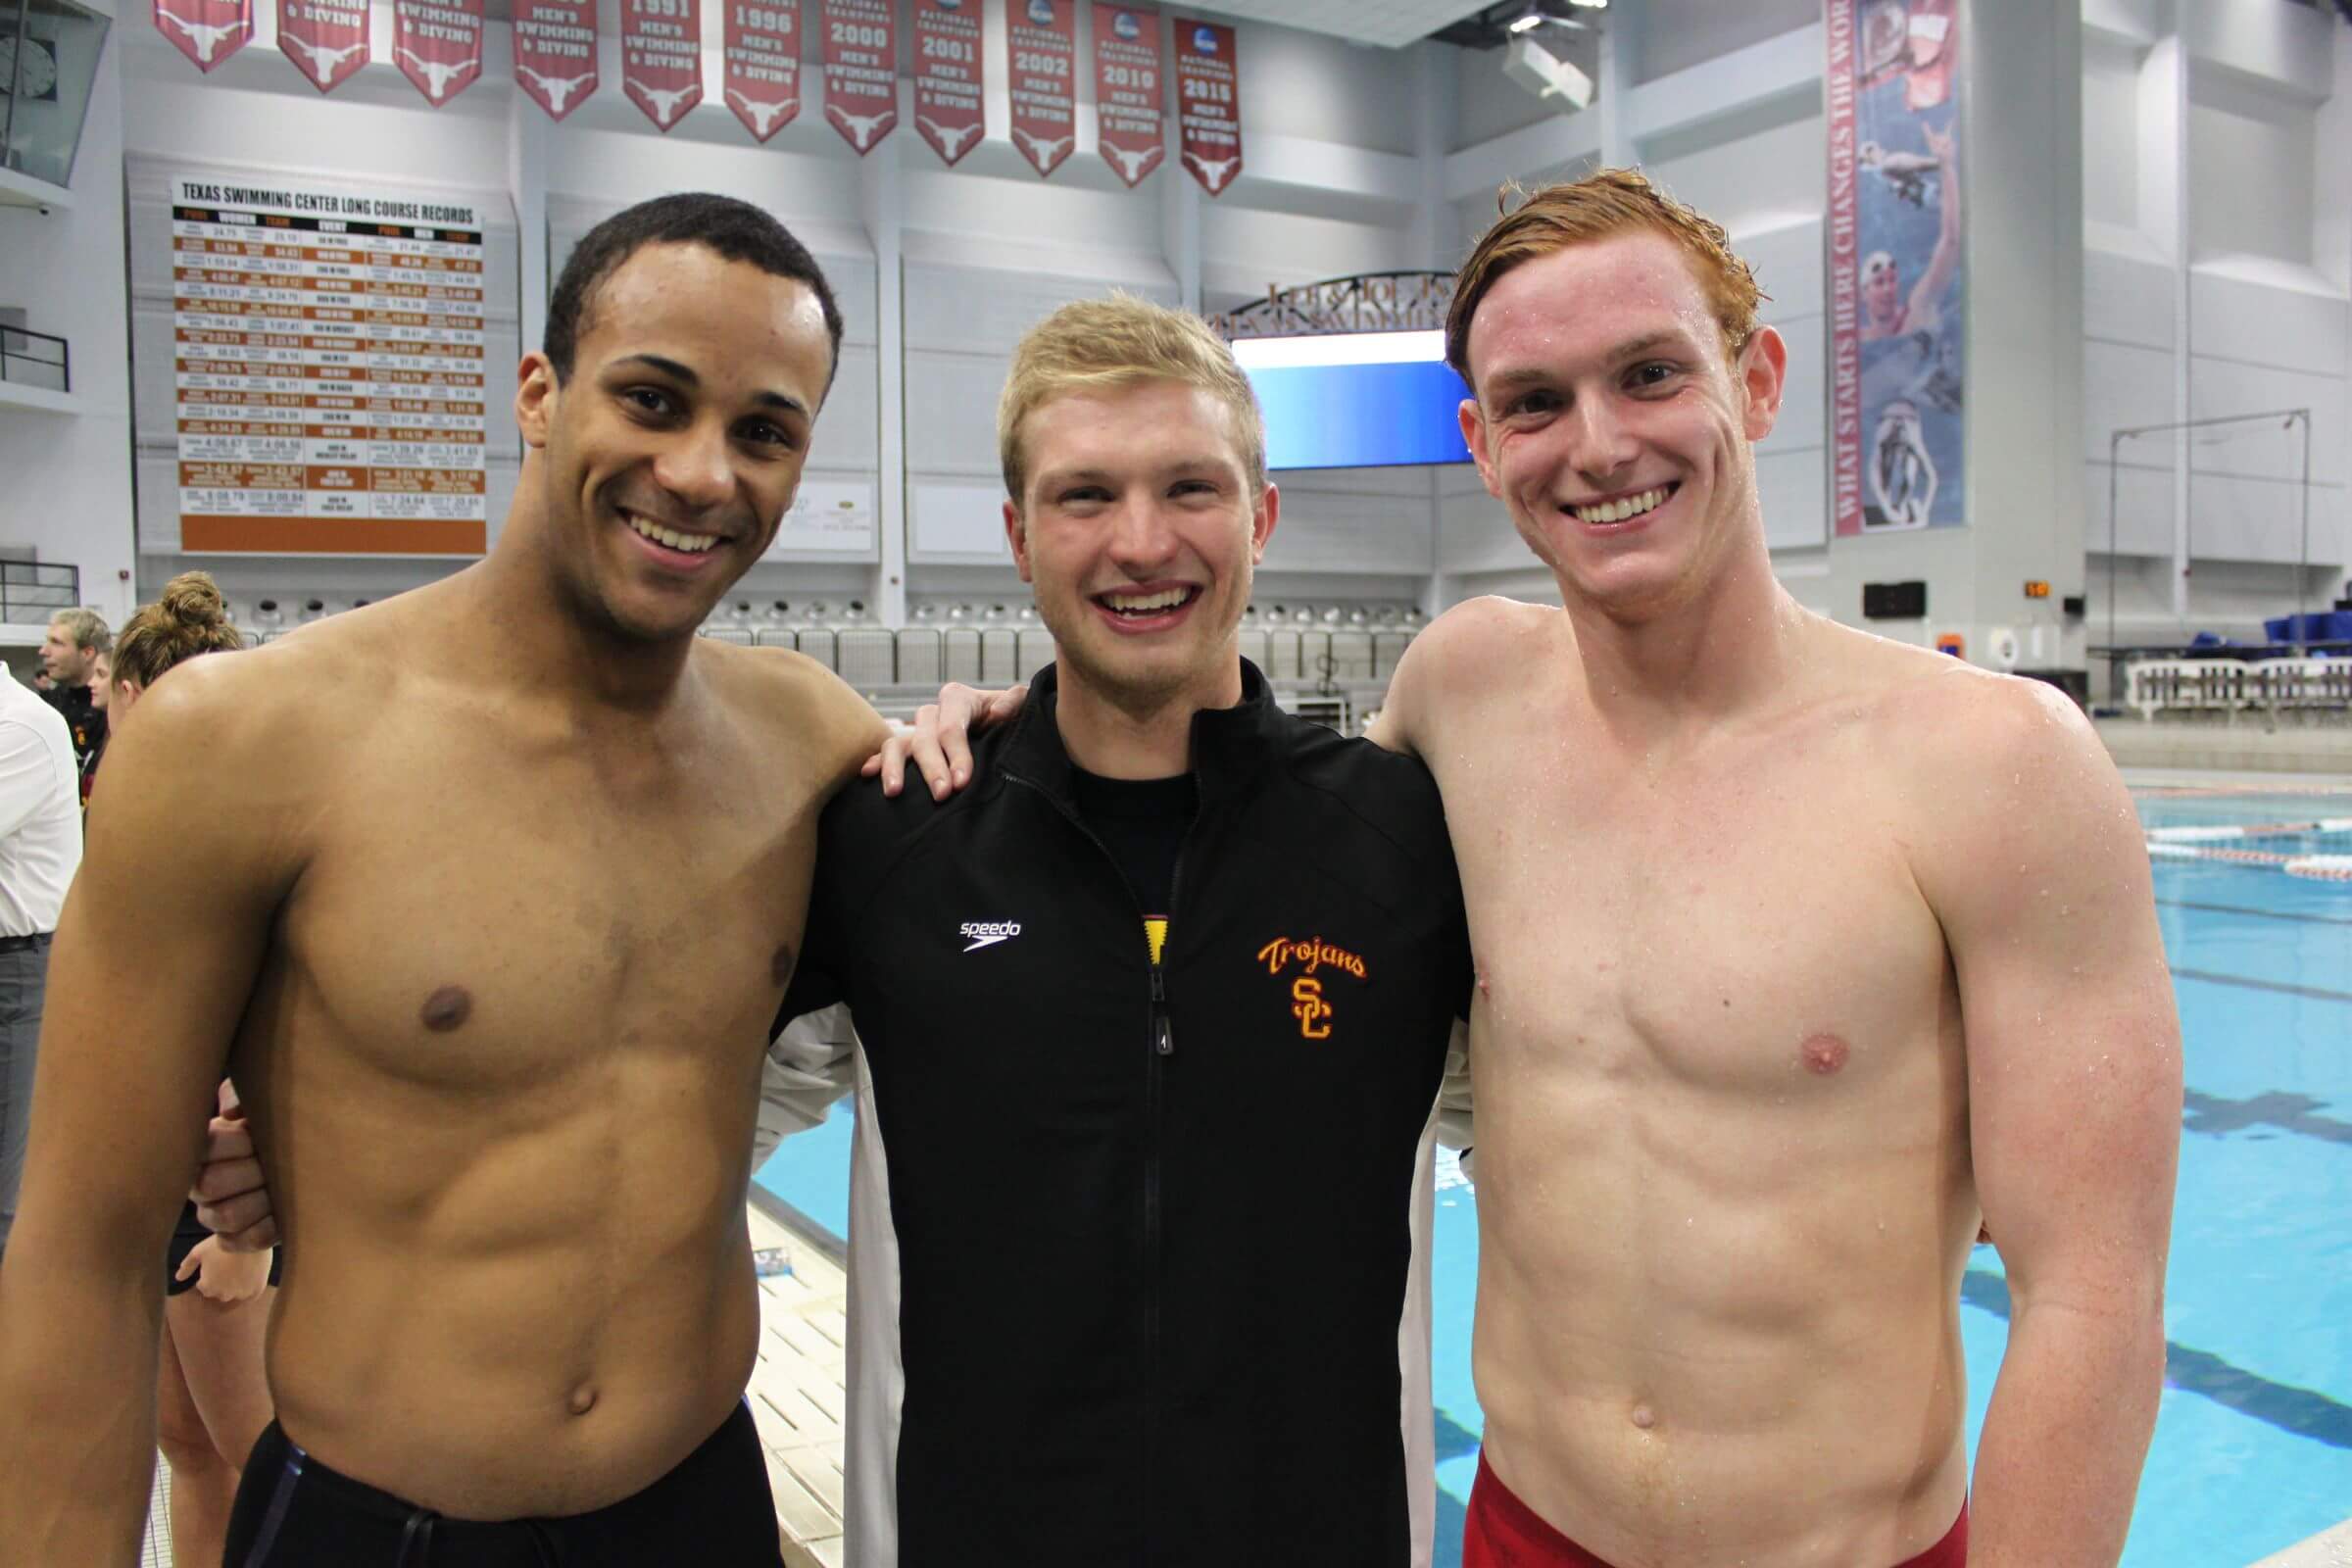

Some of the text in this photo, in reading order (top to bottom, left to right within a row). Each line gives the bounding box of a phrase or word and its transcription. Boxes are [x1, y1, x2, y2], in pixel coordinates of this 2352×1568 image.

[304, 5, 361, 27] DIVING
[398, 1, 479, 28] SWIMMING
[532, 6, 578, 24] MEN'S
[736, 5, 792, 33] 1996
[418, 22, 472, 43] DIVING
[516, 20, 594, 43] SWIMMING
[640, 21, 683, 37] MEN'S
[830, 22, 887, 47] 2000
[537, 39, 588, 58] DIVING
[626, 35, 698, 54] SWIMMING
[742, 34, 782, 52] MEN'S
[923, 36, 973, 63] 2001
[644, 52, 695, 71] DIVING
[727, 46, 797, 71] SWIMMING
[1015, 51, 1068, 75] 2002
[746, 65, 793, 84] DIVING
[825, 64, 894, 81] SWIMMING
[1102, 64, 1154, 89] 2010
[917, 76, 980, 95] SWIMMING
[1831, 66, 1853, 125] THE
[1833, 126, 1855, 255] CHANGES
[182, 182, 474, 224] TEXAS SWIMMING CENTER LONG COURSE RECORDS
[1309, 308, 1445, 331] SWIMMIN
[1837, 337, 1858, 437] STARTS
[1838, 441, 1859, 519] WHAT
[959, 919, 1021, 937] speedo
[1257, 936, 1368, 979] Trojans
[1292, 977, 1333, 1039] SC
